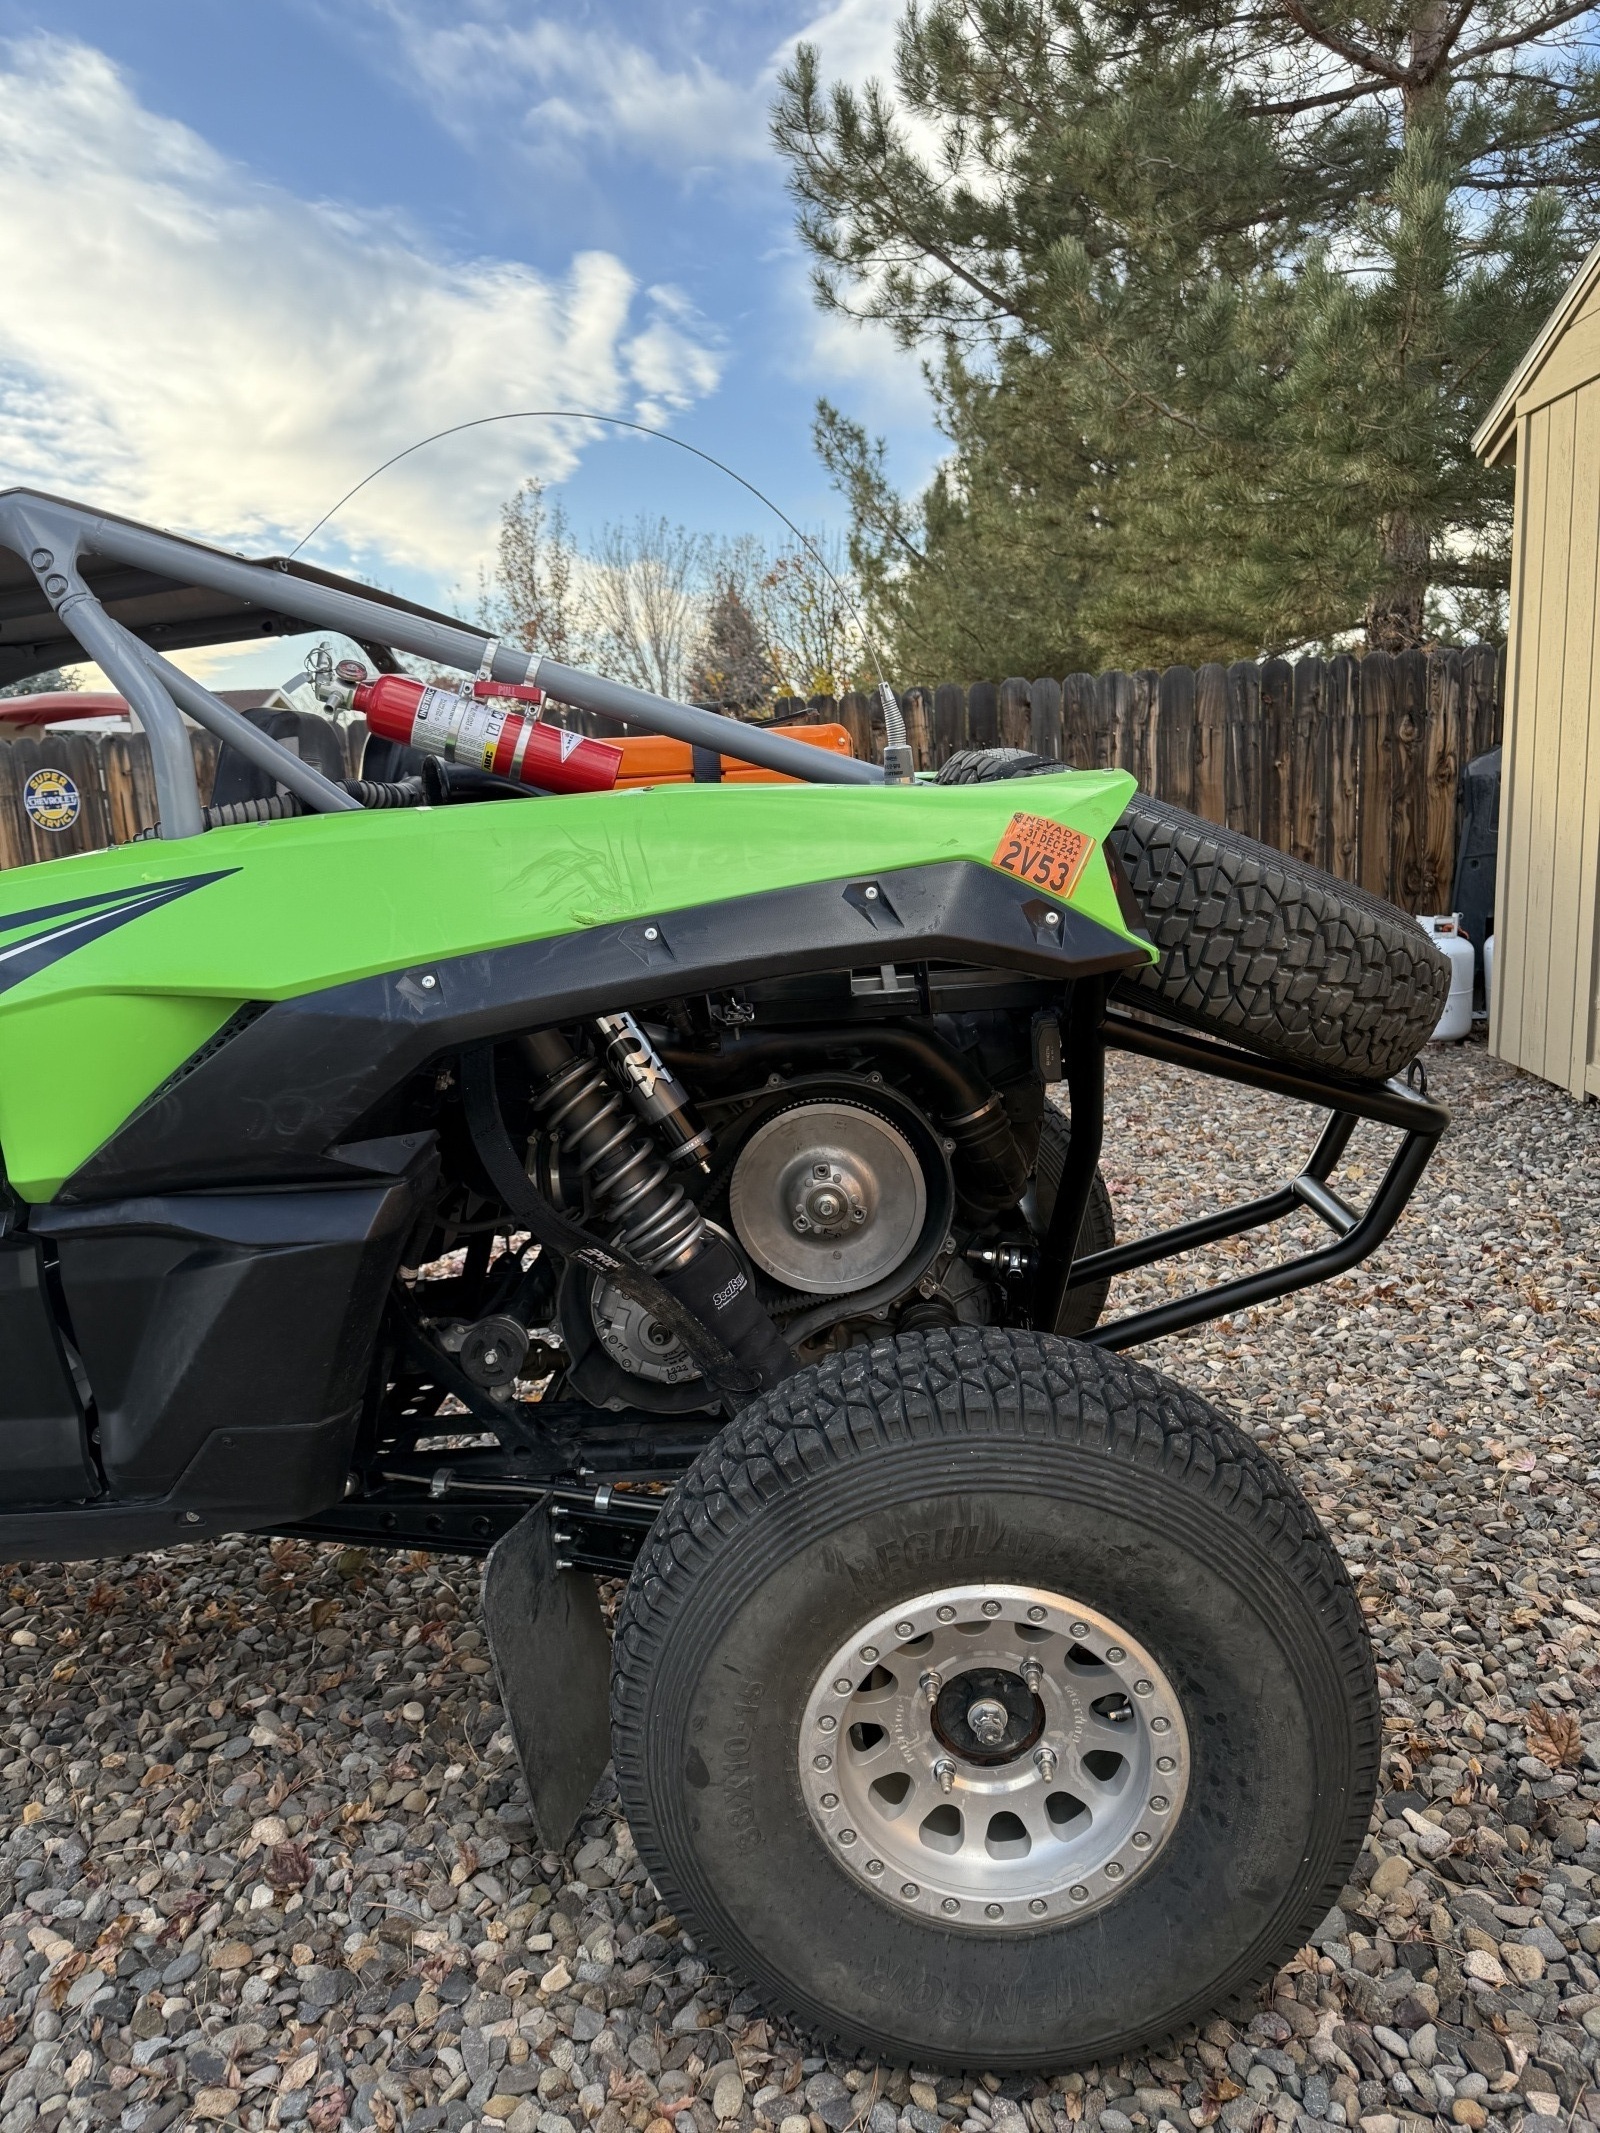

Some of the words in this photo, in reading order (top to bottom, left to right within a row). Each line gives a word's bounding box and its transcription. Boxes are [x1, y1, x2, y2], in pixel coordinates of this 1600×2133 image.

[497, 685, 516, 697] PULL
[483, 750, 494, 770] ABC
[31, 773, 67, 789] SUPER
[29, 796, 76, 806] CHEVROLET
[34, 809, 75, 827] SERVICE
[1025, 815, 1082, 843] NEVADA
[1026, 828, 1037, 840] 31
[1039, 833, 1060, 849] DEC
[1060, 843, 1074, 855] 24
[999, 840, 1070, 891] 2V53
[596, 1011, 674, 1099] FOX
